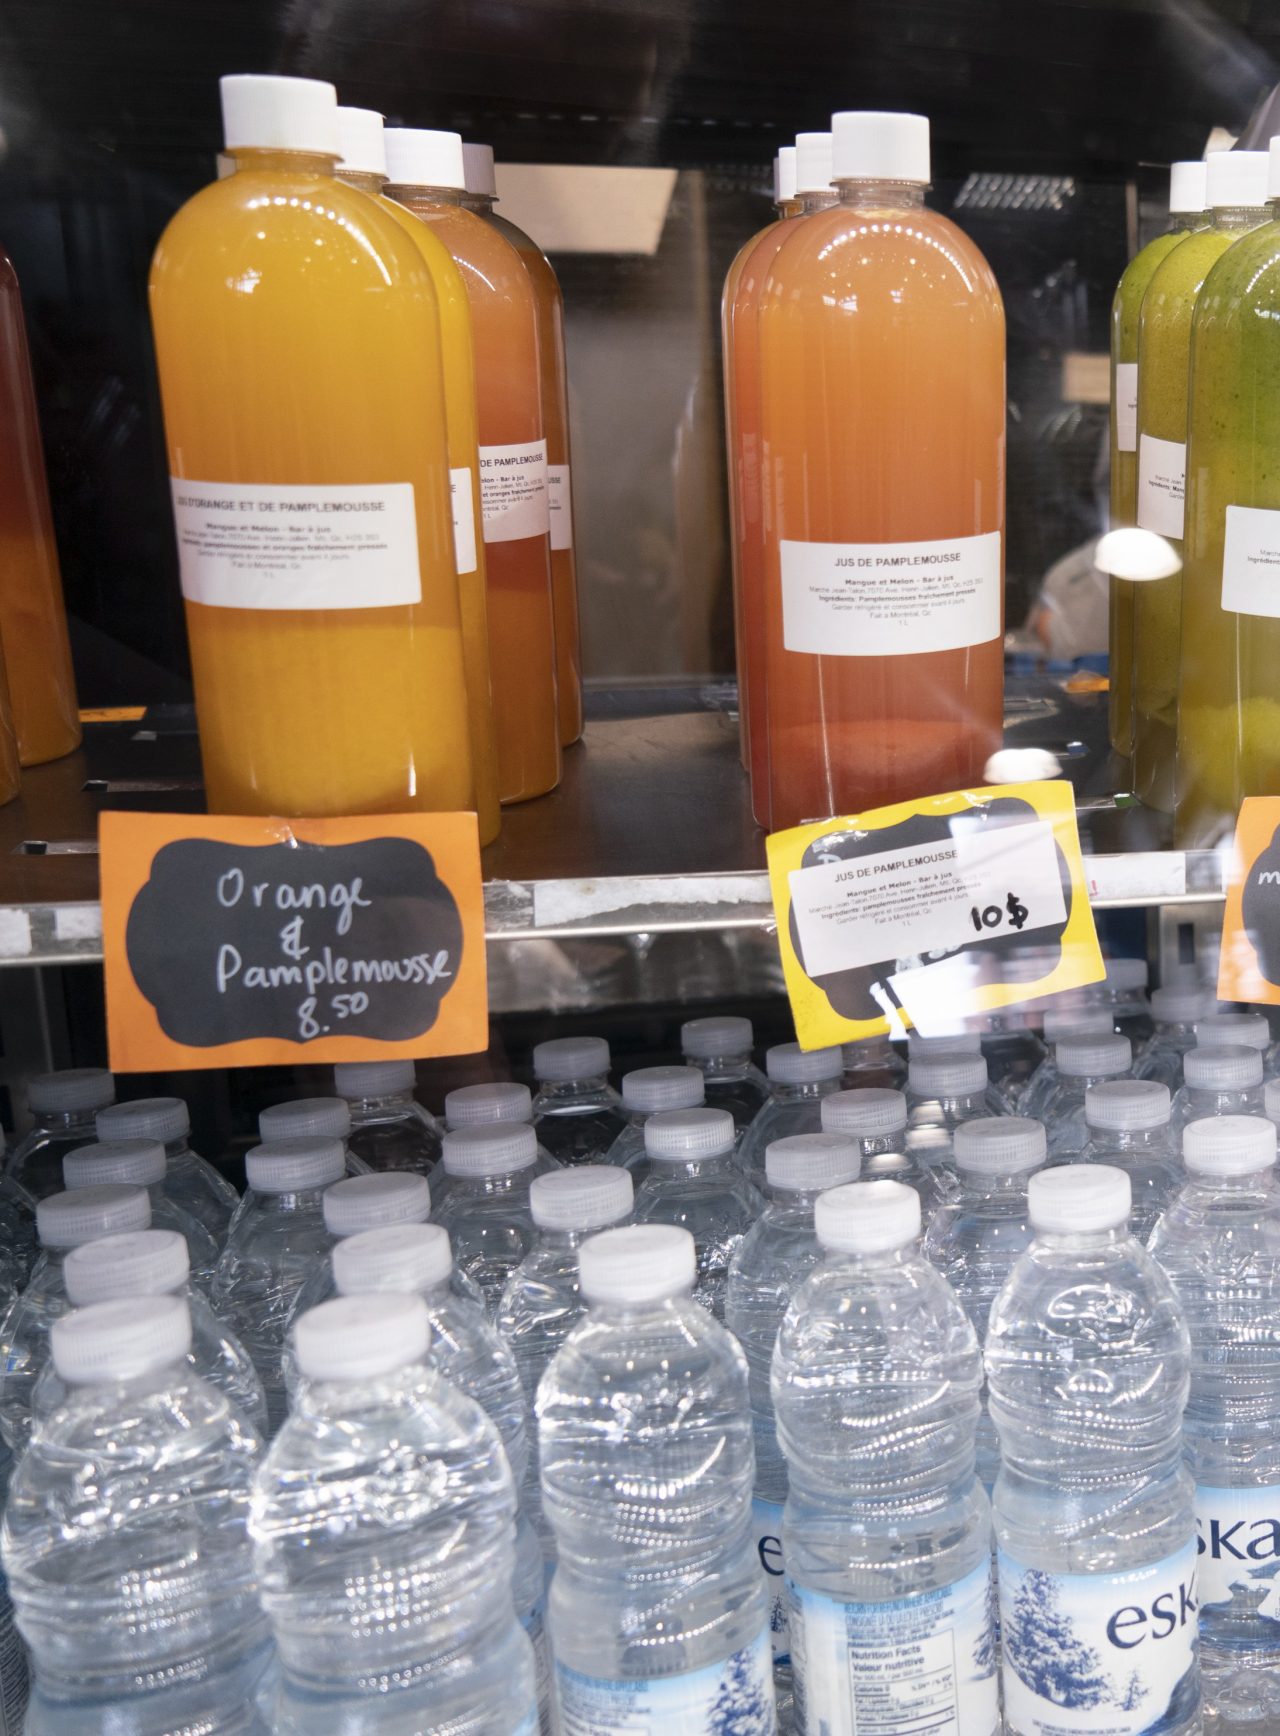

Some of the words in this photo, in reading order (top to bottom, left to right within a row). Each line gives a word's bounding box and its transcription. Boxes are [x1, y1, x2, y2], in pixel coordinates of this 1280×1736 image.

[480, 459, 492, 467] DE
[494, 454, 543, 466] PAMPLEMOUSSE
[240, 501, 254, 511] ET
[259, 502, 275, 512] DE
[280, 502, 386, 513] PAMPLEMOUSSE
[835, 557, 855, 567] JUS
[858, 557, 872, 567] DE
[876, 552, 961, 567] PAMPLEMOUSSE
[845, 579, 877, 587] Mangue
[834, 871, 855, 883] JUS
[857, 868, 872, 879] DE
[873, 849, 958, 875] PAMPLEMOUSSE
[847, 887, 877, 898] Mangue
[889, 880, 911, 890] Melon
[918, 875, 932, 883] Bar
[934, 873, 938, 881] à
[941, 872, 953, 881] jus
[216, 868, 372, 935] Orange
[863, 896, 916, 912] pamplemousses
[917, 886, 955, 899] fraîchement
[970, 891, 1029, 932] 10$
[875, 917, 887, 925] Fait
[280, 915, 309, 960] &
[217, 944, 452, 994] Pamplemousse
[297, 991, 370, 1039] 8.50
[852, 1651, 893, 1660] Nutrition
[896, 1645, 921, 1657] Facts
[853, 1663, 882, 1672] Valeur
[885, 1656, 925, 1670] nutritive
